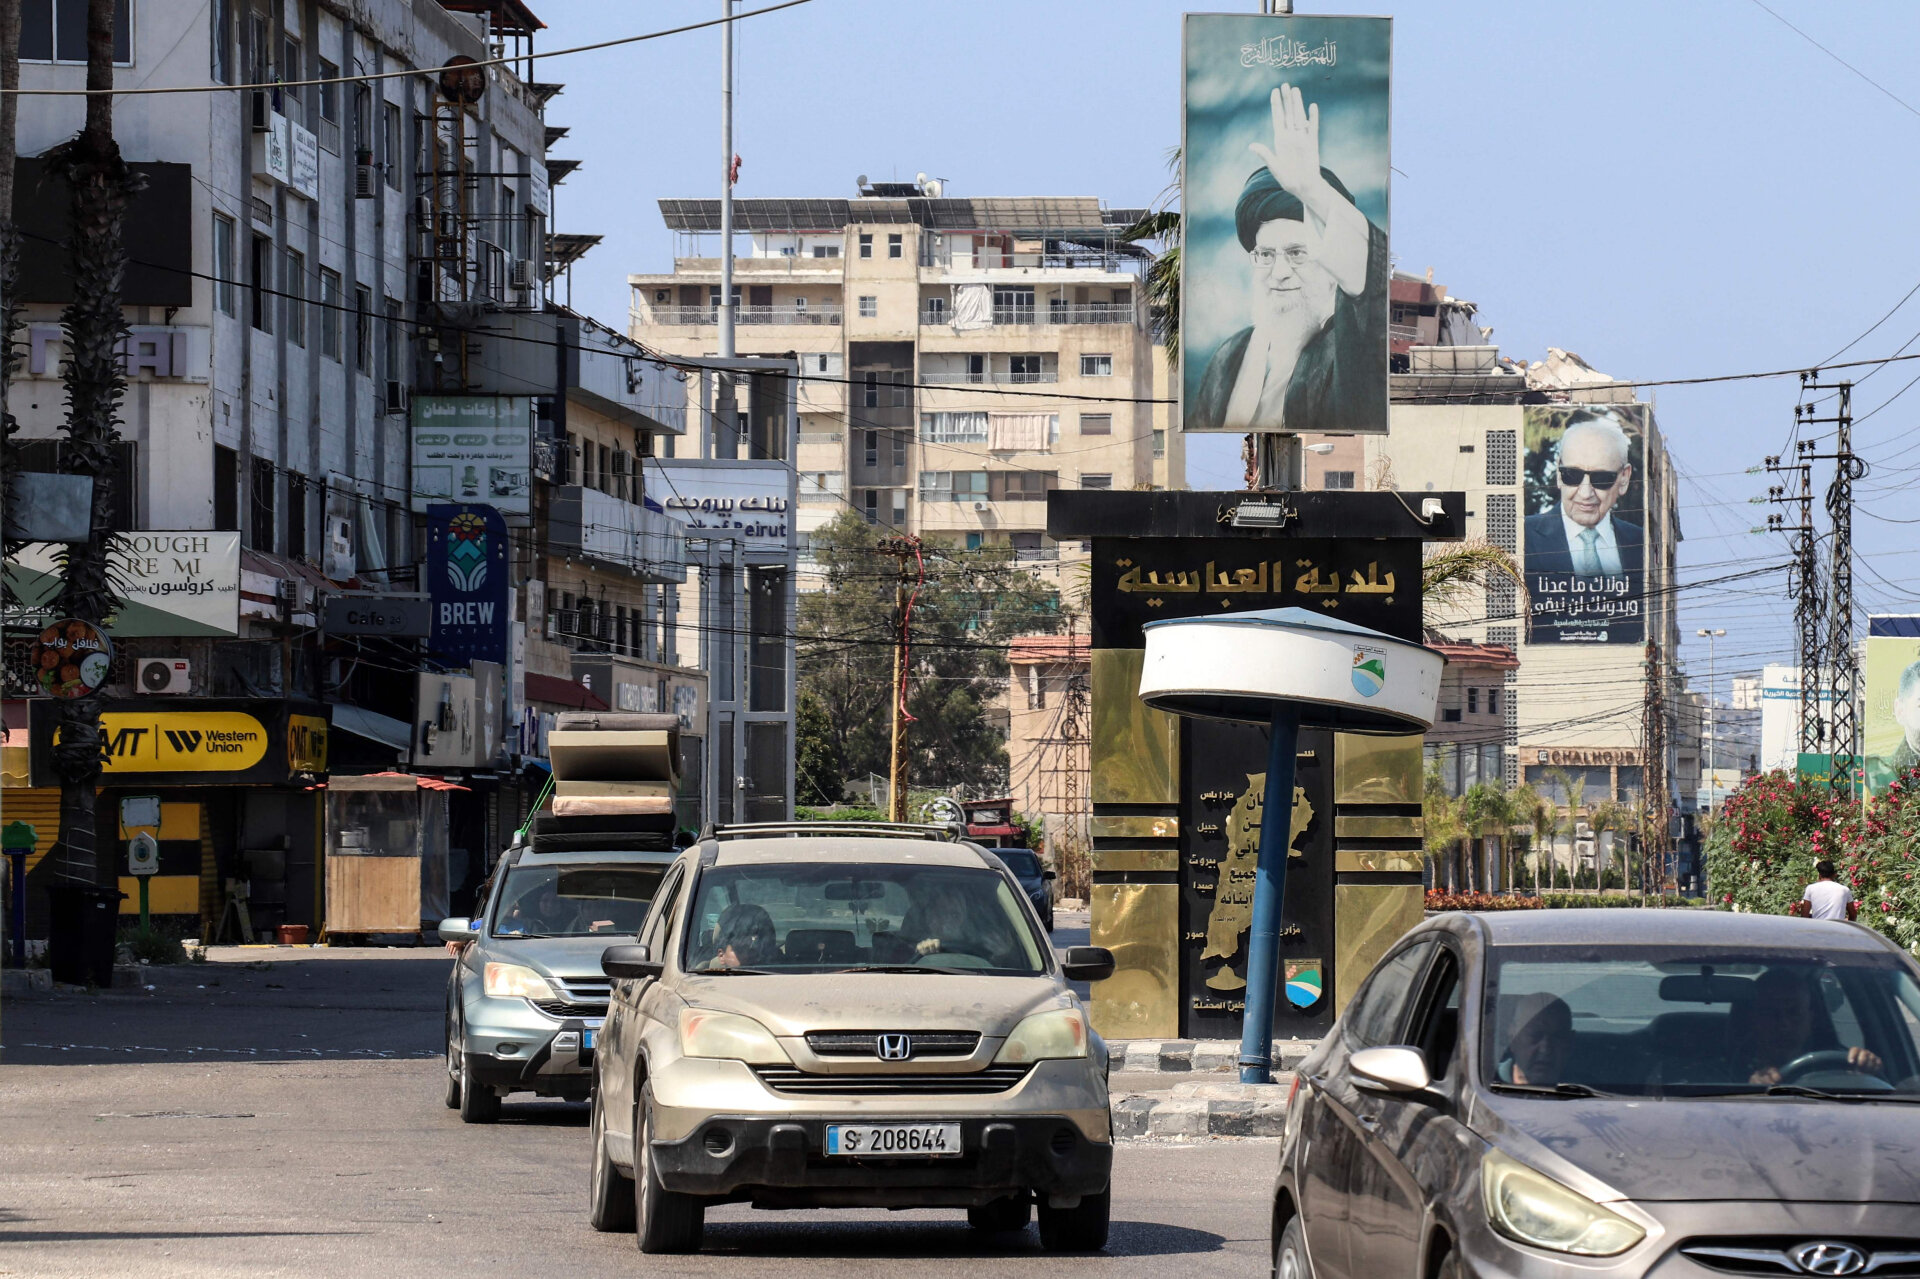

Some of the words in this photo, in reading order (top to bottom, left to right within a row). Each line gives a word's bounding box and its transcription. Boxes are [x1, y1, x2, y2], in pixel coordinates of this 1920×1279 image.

[1302, 37, 1337, 66] اللهم
[665, 497, 734, 517] بيروت
[739, 496, 787, 518] بنك
[116, 536, 208, 553] DOUGH
[126, 557, 158, 578] RE
[172, 557, 201, 578] MI
[123, 585, 147, 593] بالجنو
[217, 583, 237, 592] أطيب
[1116, 557, 1283, 608] العباسية
[1294, 558, 1396, 607] بلدية
[1539, 576, 1568, 593] عدنا
[1571, 575, 1586, 593] ما
[1590, 575, 1630, 596] لولاك
[440, 602, 495, 625] BREW
[1568, 595, 1583, 616] لن
[1587, 595, 1639, 616] وبدونك
[347, 610, 386, 627] Cafe
[72, 637, 99, 650] فلافل
[99, 727, 148, 757] MT
[205, 730, 257, 742] Western
[206, 742, 243, 753] Union
[1200, 790, 1234, 802] طرابلس
[1197, 822, 1219, 833] جبيل
[1189, 854, 1216, 868] بيروت
[1229, 869, 1256, 884] جميع
[1193, 881, 1214, 892] صيدا
[1186, 931, 1205, 940] صور
[844, 1129, 858, 1151] S
[870, 1129, 947, 1151] 208644
